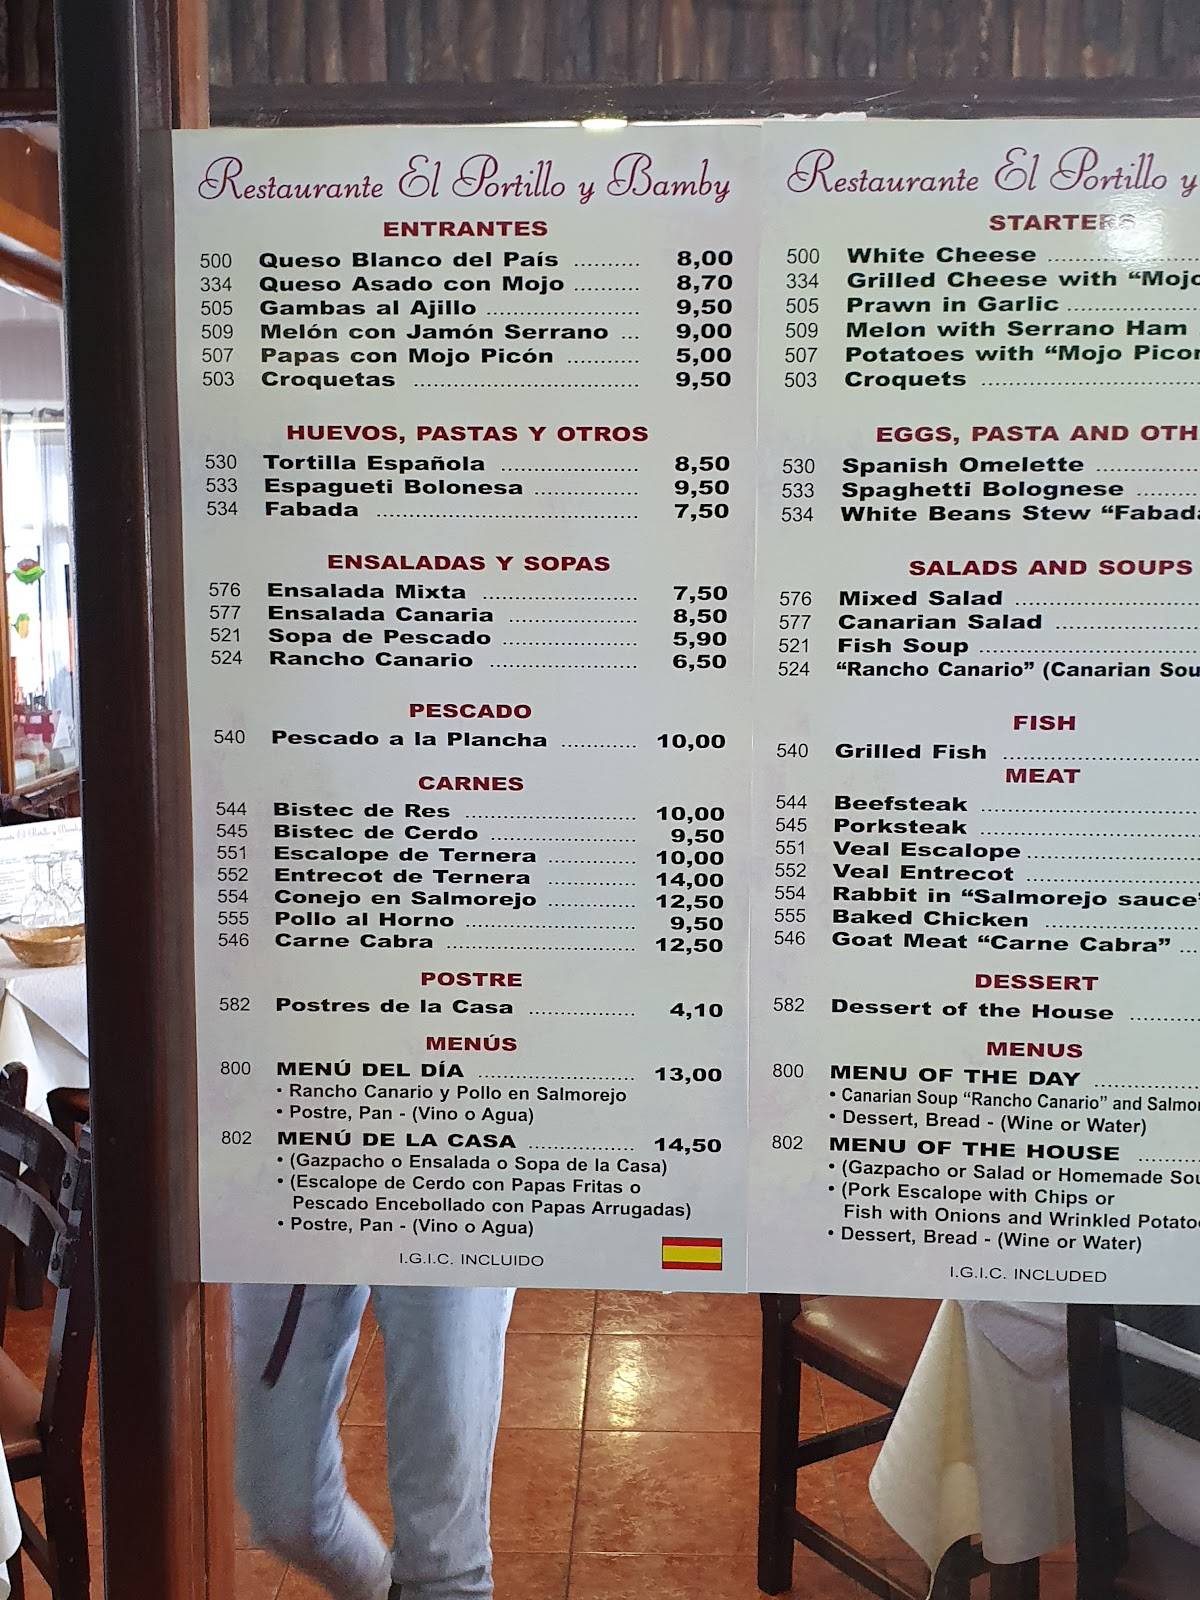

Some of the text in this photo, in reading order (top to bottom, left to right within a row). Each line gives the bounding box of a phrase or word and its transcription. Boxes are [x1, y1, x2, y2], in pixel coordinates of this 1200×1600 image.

[198, 152, 730, 205] Restaurante El Portillo y Bamby
[787, 146, 1198, 198] Restaurante El Portillo y
[384, 221, 548, 237] ENTRANTES
[200, 250, 733, 270] 500 Queso Blanco del País 8,00
[787, 247, 1036, 264] 500 White Cheese
[201, 299, 732, 319] 505 Gambas al Ajillo 9,50
[786, 296, 1059, 314] 505 Prawn in Garlic
[202, 347, 732, 367] 507 Papas con Mojo Picón 5,00
[784, 371, 966, 391] 503 Croquets
[287, 425, 648, 444] HUEVOS, PASTAS Y OTROS
[876, 426, 960, 446] EGGS,
[972, 425, 1059, 442] PASTA
[1069, 425, 1129, 441] AND
[205, 454, 730, 475] 530 Tortilla Española 8,50
[782, 481, 1124, 502] 533 Spaghetti Bolognese
[206, 501, 729, 522] 534 Fabada 7,50
[328, 554, 610, 571] ENSALADAS Y SOPAS
[909, 560, 1193, 576] SALADS AND SOUPS
[779, 590, 1003, 606] 576 Mixed Salad
[209, 605, 727, 627] 577 Ensalada Canaria 8,50
[779, 614, 1042, 630] 577 Canarian Salad
[778, 638, 969, 657] 521 Fish Soup
[211, 650, 727, 672] 524 Rancho Canario 6,50
[409, 703, 532, 719] PESCADO
[1013, 715, 1076, 731] FISH
[214, 729, 726, 752] 540 Pescado a la Plancha 10,00
[418, 776, 524, 791] CARNES
[1006, 768, 1081, 784] MEAT
[216, 823, 724, 846] 545 Bistec de Cerdo 9,50
[775, 840, 1021, 862] 551 Veal Escalope
[217, 867, 724, 890] 552 Entrecot de Ternera 14,00
[774, 908, 1028, 928] 555 Baked Chicken
[774, 930, 805, 945] 546
[832, 931, 893, 947] Goat
[904, 933, 968, 949] Meat
[421, 972, 522, 987] POSTRE
[975, 974, 1099, 991] DESSERT
[773, 997, 1114, 1020] 582 Dessert of the House
[426, 1036, 517, 1052] MENÚS
[987, 1041, 1083, 1058] MENUS
[220, 1061, 722, 1085] 800 MENÚ DEL DÍA 13,00
[773, 1063, 1081, 1087] 800 MENU OF THE DAY
[290, 1083, 627, 1105] Rancho Canario y Pollo en Salmorejo
[290, 1174, 641, 1195] (Escalope de Cerdo con Papas Fritas o
[842, 1181, 1115, 1208] (Pork Escalope with Chips or
[400, 1253, 544, 1267] I.G.I.C. INCLUIDO
[950, 1266, 1107, 1283] I.G.I.C. INCLUDED
